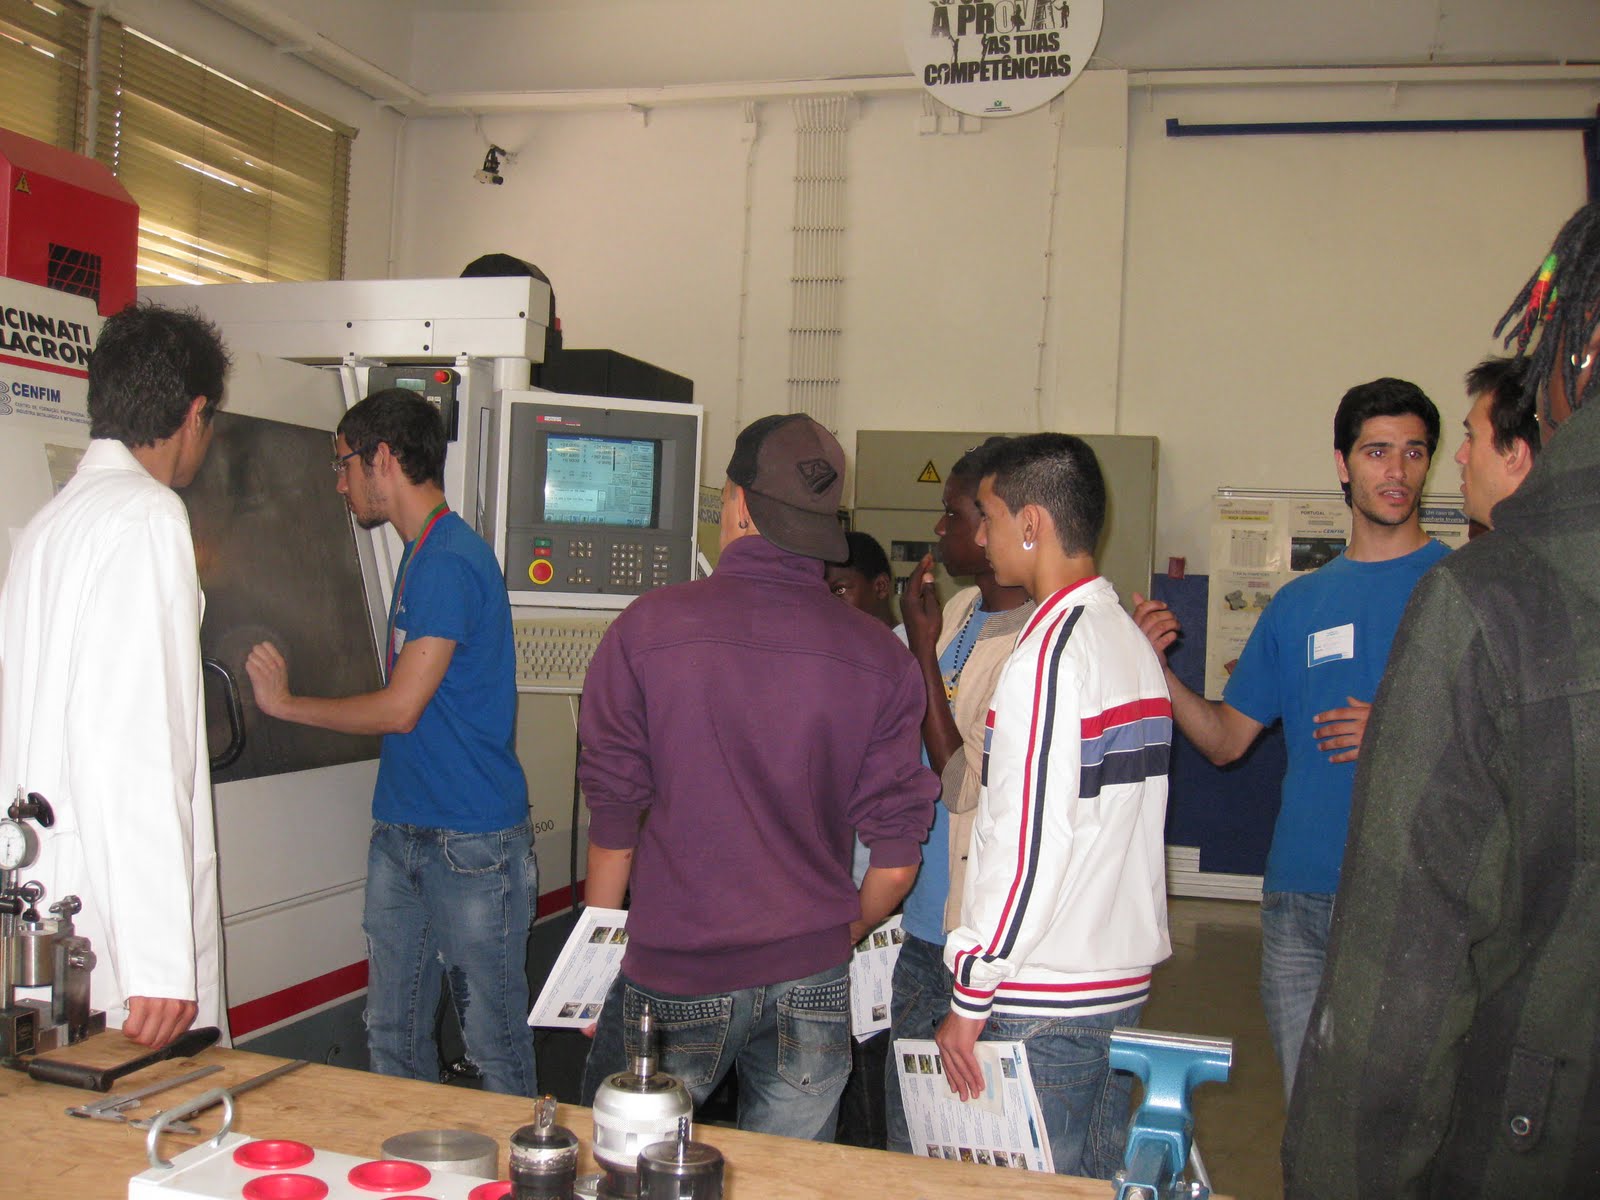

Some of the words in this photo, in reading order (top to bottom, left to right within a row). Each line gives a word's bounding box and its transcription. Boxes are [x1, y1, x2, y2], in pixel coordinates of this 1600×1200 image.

[957, 0, 1057, 36] PROVA
[986, 35, 1011, 55] AS
[1014, 32, 1060, 55] TUAS
[924, 54, 1072, 86] COMPETÊNCIAS
[12, 382, 61, 403] CENFIM
[535, 819, 555, 834] 500
